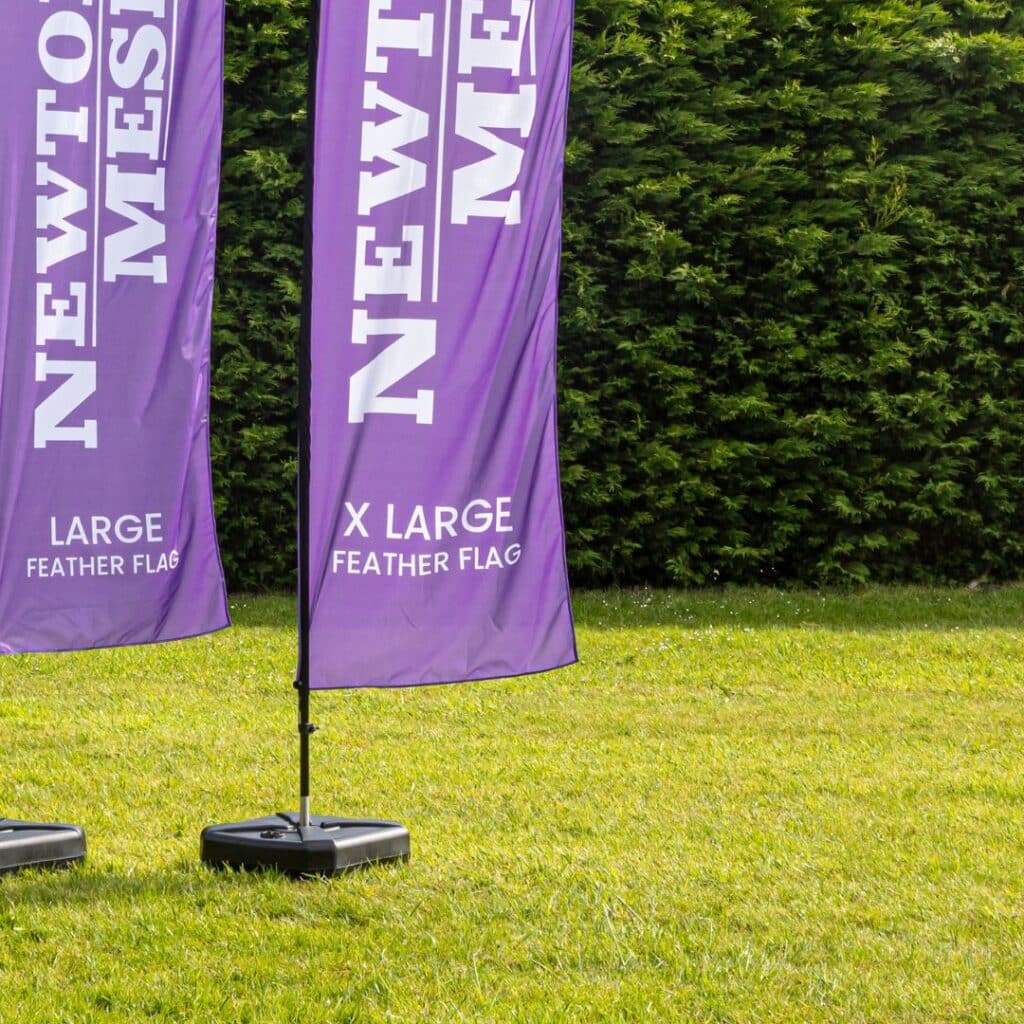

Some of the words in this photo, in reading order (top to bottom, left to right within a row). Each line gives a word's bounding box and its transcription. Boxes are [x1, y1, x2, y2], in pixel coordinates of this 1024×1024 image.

[50, 513, 163, 546] LARGE
[343, 501, 371, 538] X
[386, 496, 513, 541] LARGE
[26, 555, 126, 578] FEATHER
[132, 549, 180, 575] FLAG
[332, 550, 450, 576] FEATHER
[459, 543, 522, 571] FLAG
